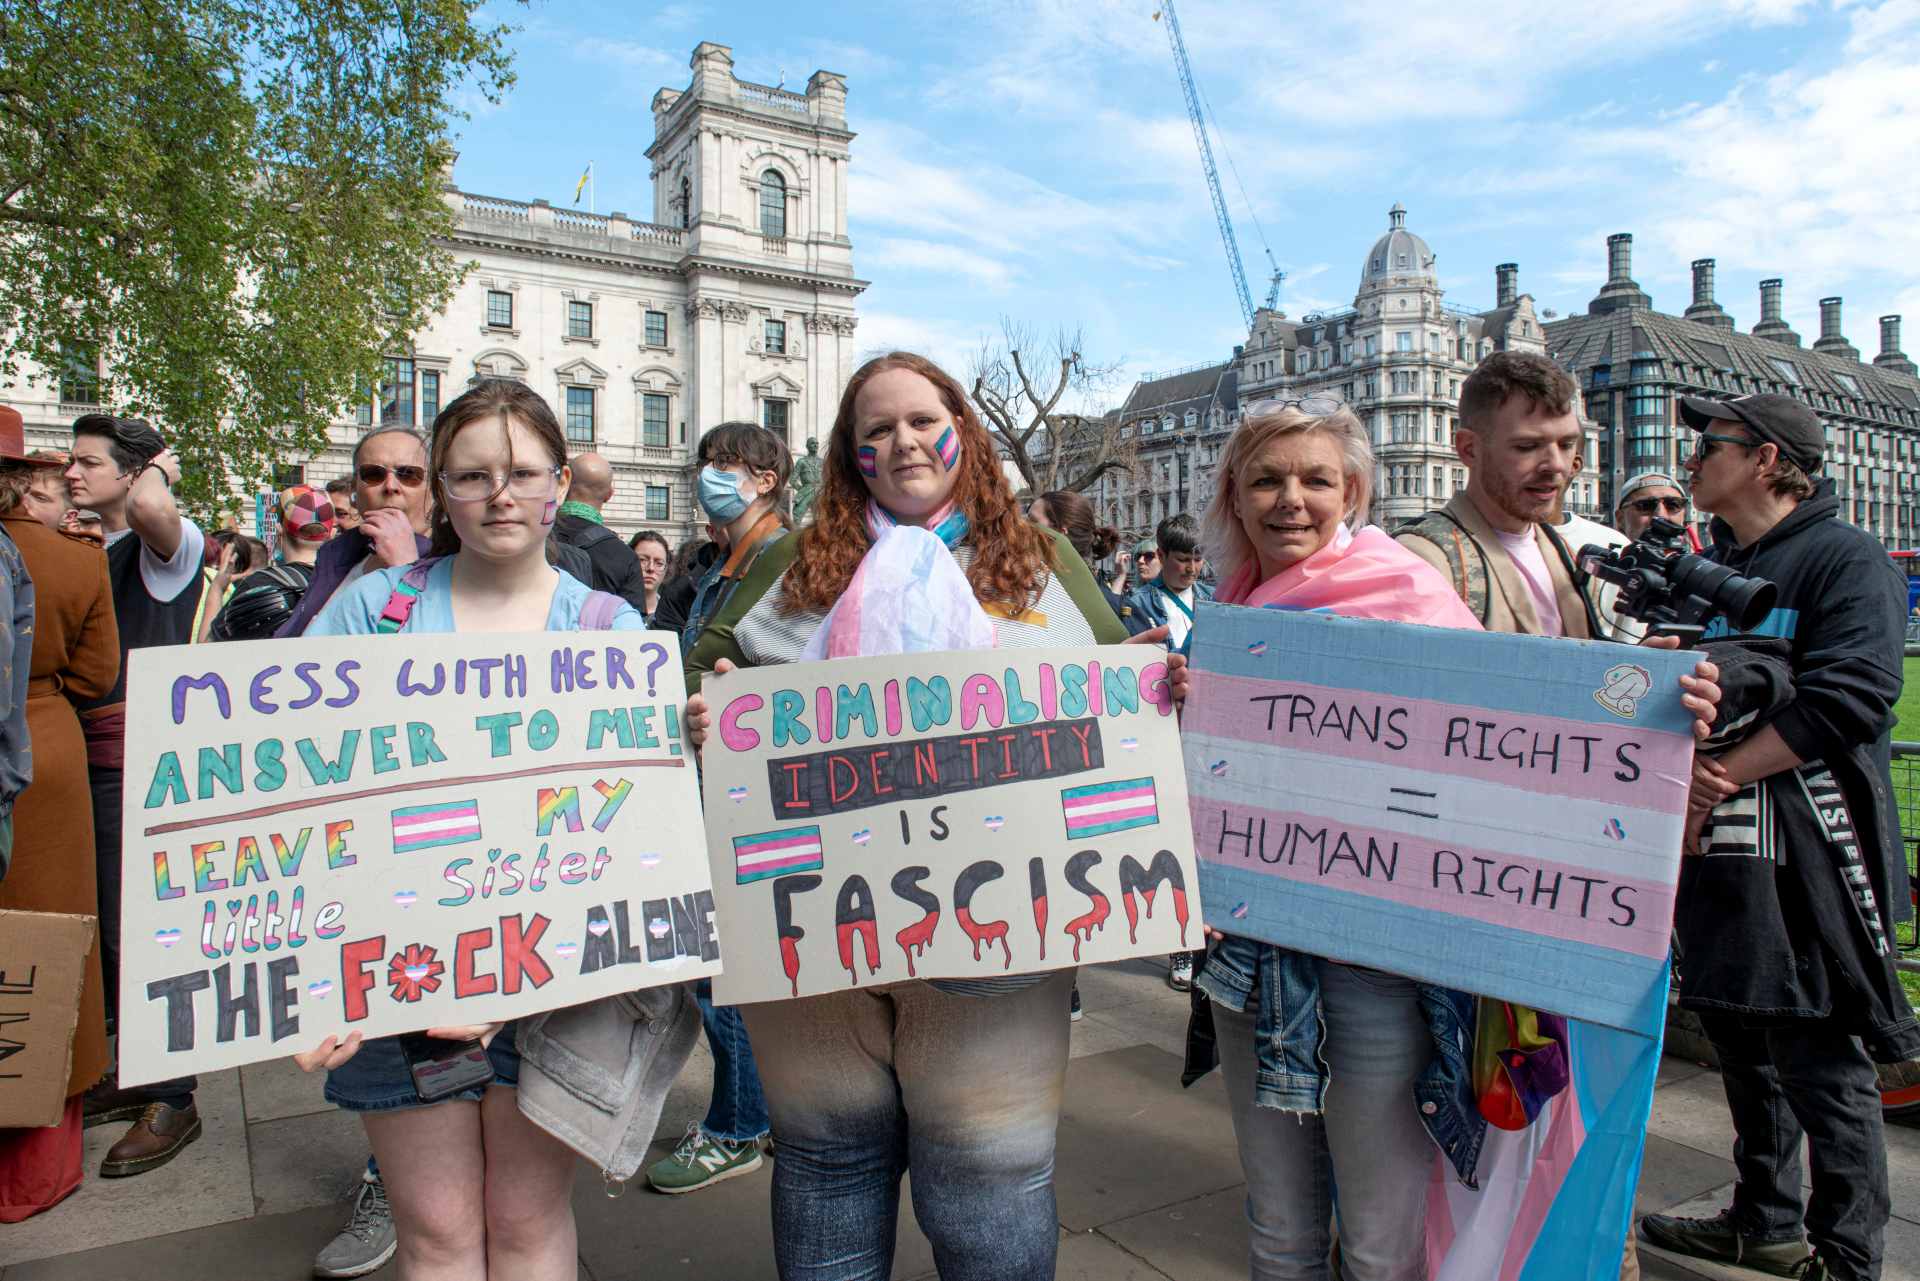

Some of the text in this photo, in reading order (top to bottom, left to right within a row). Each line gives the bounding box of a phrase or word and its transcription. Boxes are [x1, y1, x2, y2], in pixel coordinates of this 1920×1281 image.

[171, 642, 669, 724] MESS WITH HER?
[719, 660, 1170, 752] CRIMINALISING
[144, 704, 682, 809] ANSWER TO ME!
[783, 726, 1092, 808] IDENTITY
[1250, 693, 1641, 783] TRANS RIGHTS
[153, 778, 634, 900] LEAVE MY
[899, 805, 949, 844] IS
[1217, 810, 1638, 928] HUMAN RIGHTS
[200, 843, 612, 960] little Sister
[773, 849, 1187, 997] FASCISM
[146, 954, 300, 1053] THE
[579, 889, 720, 975] ALONE
